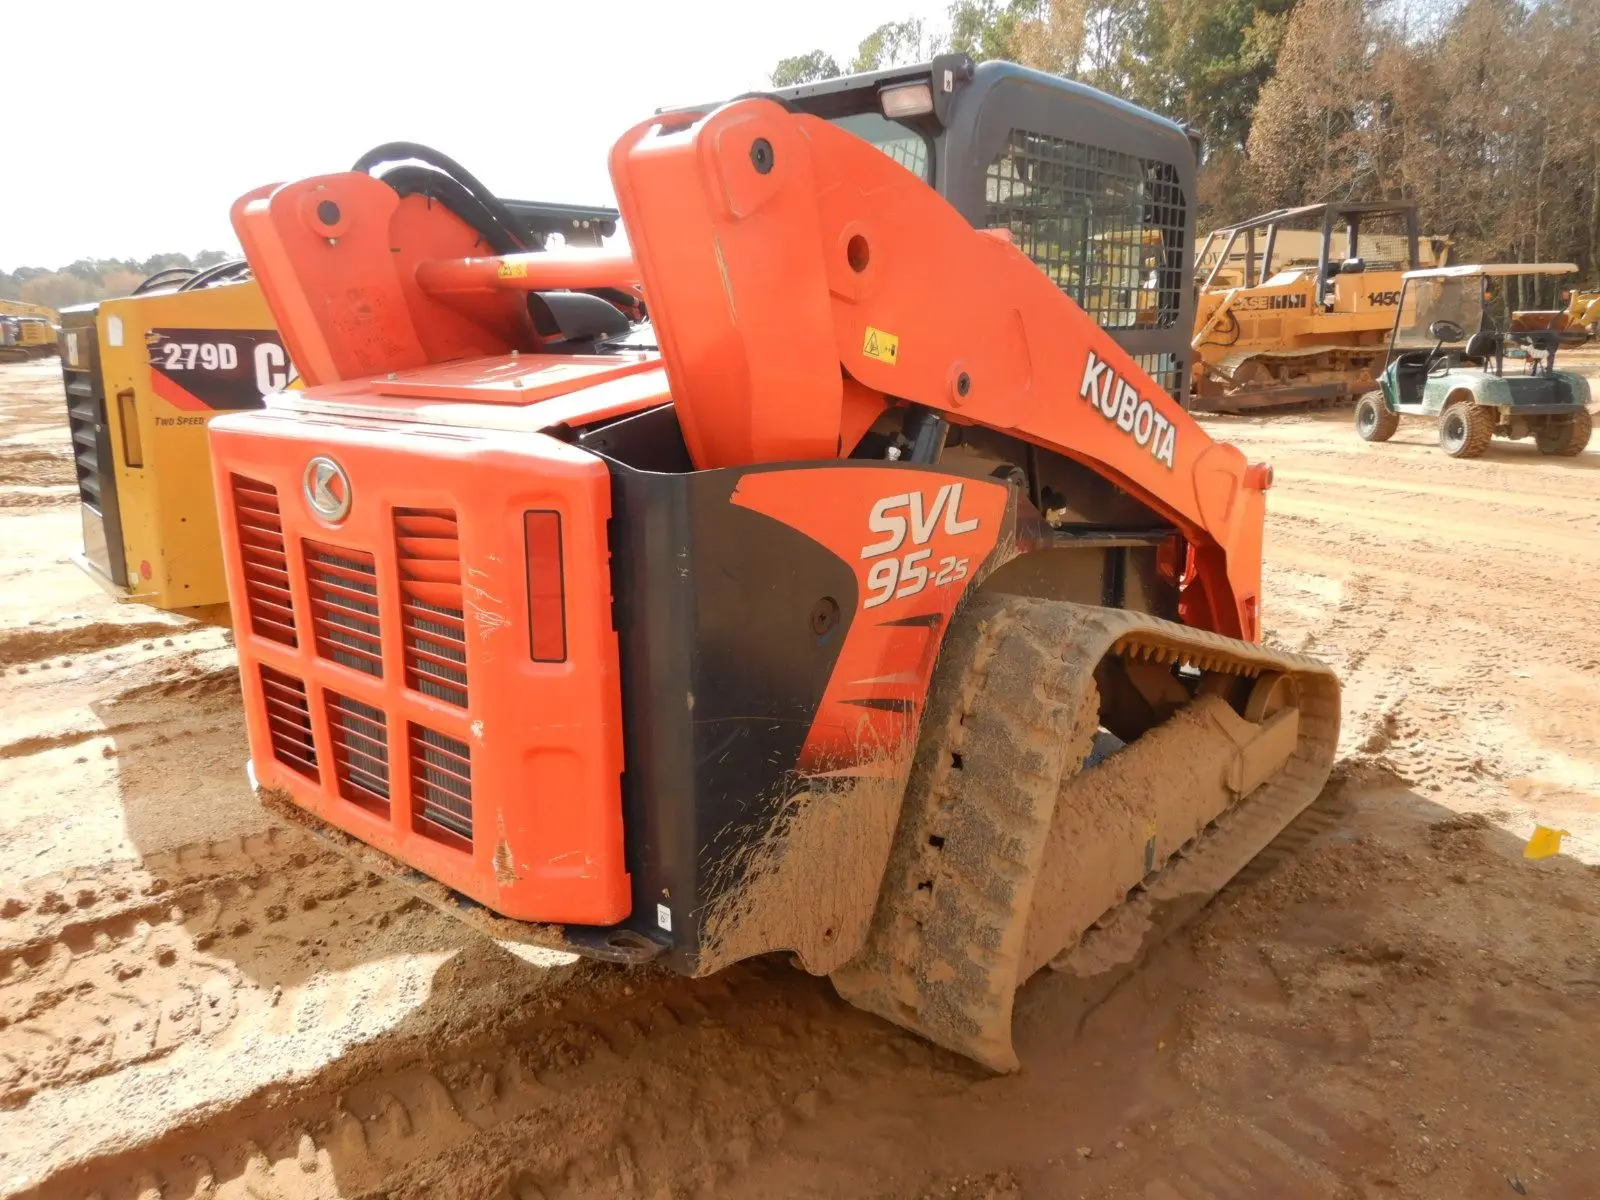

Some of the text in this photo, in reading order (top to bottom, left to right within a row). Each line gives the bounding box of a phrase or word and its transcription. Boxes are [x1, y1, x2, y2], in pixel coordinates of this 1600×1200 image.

[163, 343, 238, 370] 279D
[1080, 350, 1176, 470] KUBOTA
[861, 483, 979, 559] SVL
